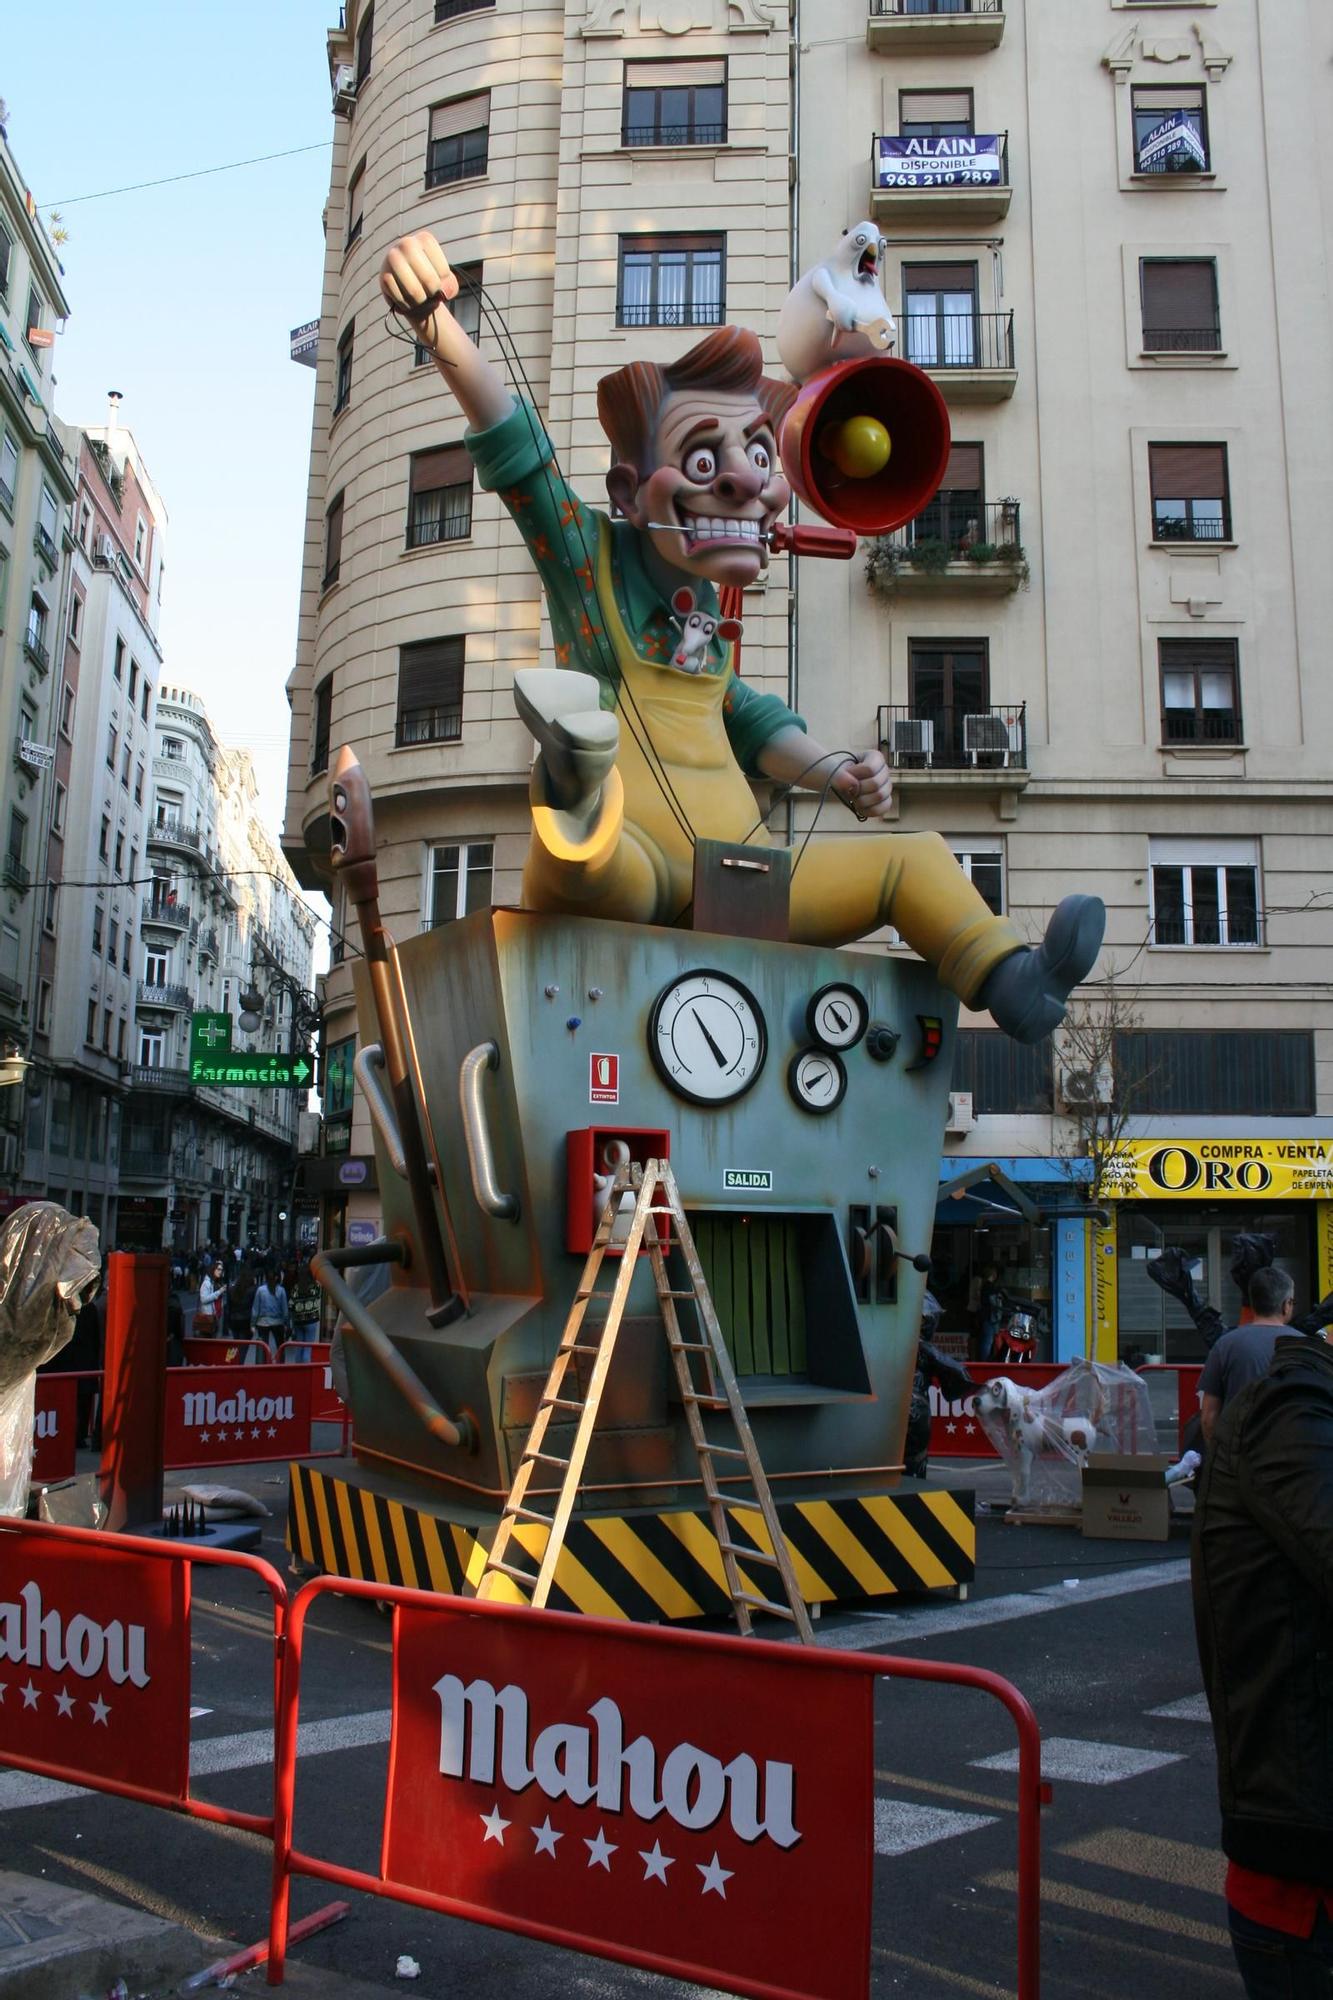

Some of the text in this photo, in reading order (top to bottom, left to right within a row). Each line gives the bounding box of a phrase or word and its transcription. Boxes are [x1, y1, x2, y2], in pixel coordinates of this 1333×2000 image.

[1148, 118, 1176, 143] ALAIN
[905, 138, 976, 155] ALAIN
[901, 159, 976, 170] DISPONIBLE
[886, 171, 992, 186] 963 210 289
[193, 1059, 290, 1081] Farmacia
[1200, 1145, 1263, 1158] COMPRA
[1277, 1145, 1326, 1158] VENTA
[1148, 1146, 1272, 1192] ORO
[727, 1172, 768, 1187] SALIDA
[1292, 1179, 1333, 1190] DE EMPEÑ
[182, 1389, 295, 1426] Mahou
[0, 1580, 151, 1688] ahou
[432, 1674, 802, 1848] Mahou
